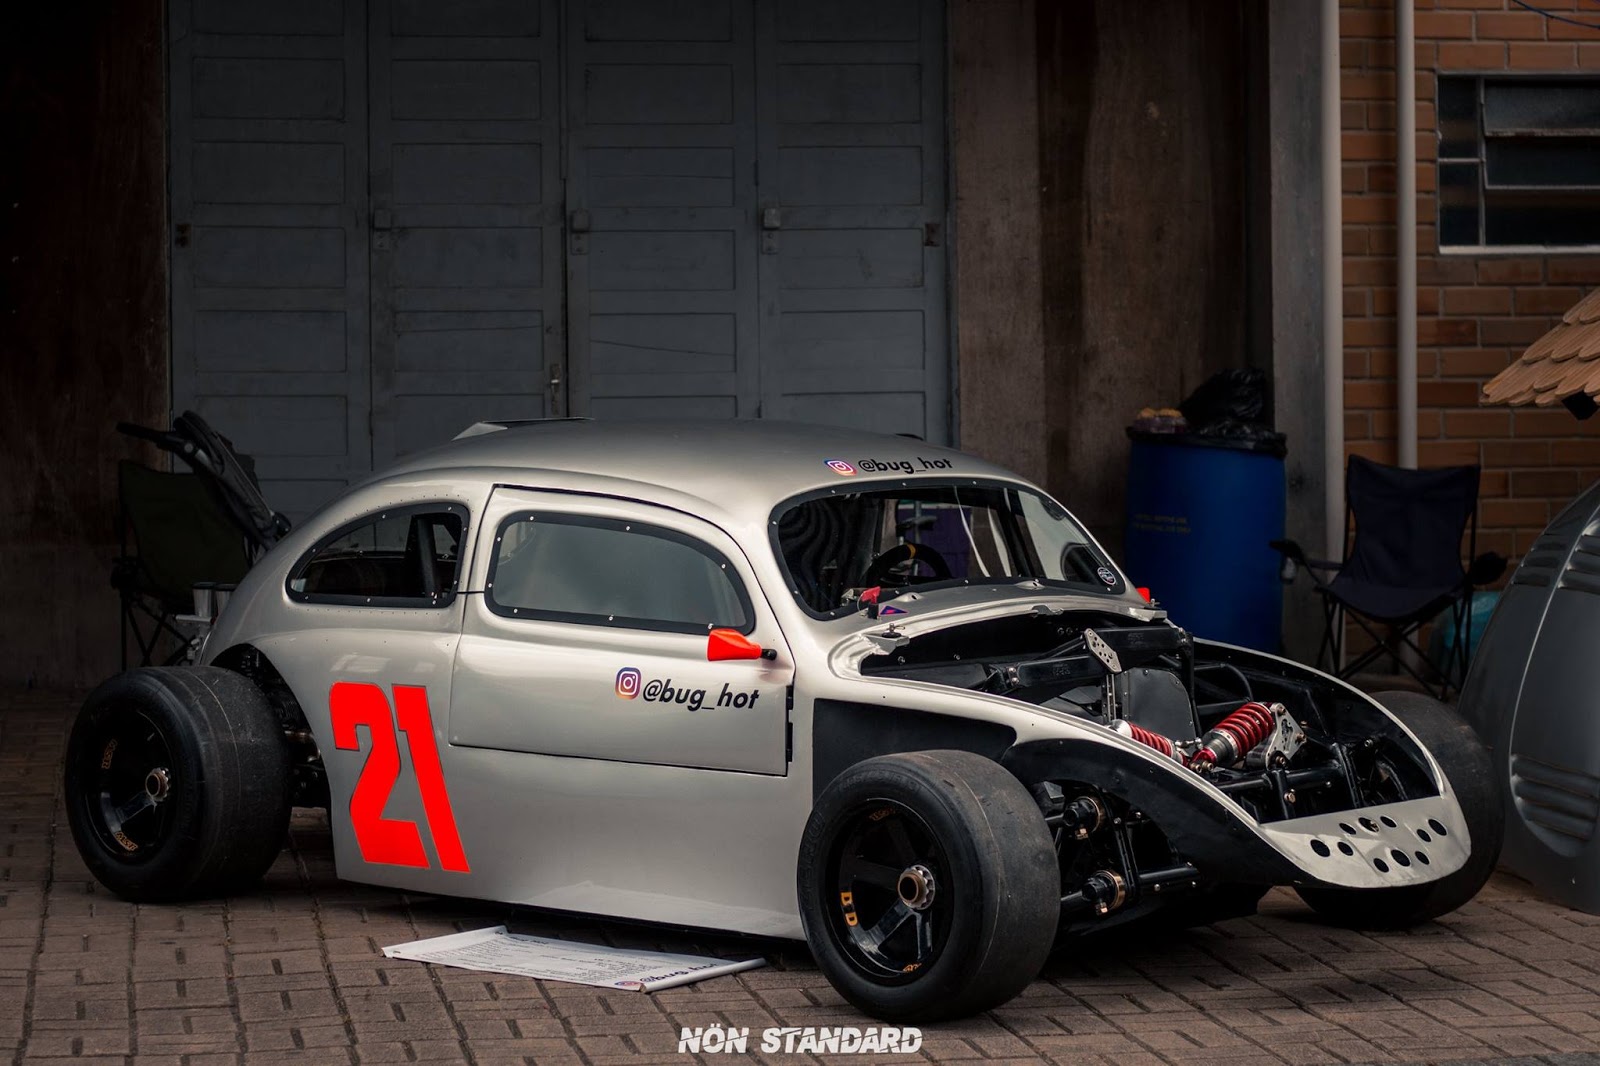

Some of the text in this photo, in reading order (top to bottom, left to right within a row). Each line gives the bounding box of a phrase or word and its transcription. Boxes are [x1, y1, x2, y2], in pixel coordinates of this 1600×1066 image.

[858, 456, 953, 475] @bug_hot
[643, 679, 760, 711] @bug_hot
[330, 682, 471, 873] 21
